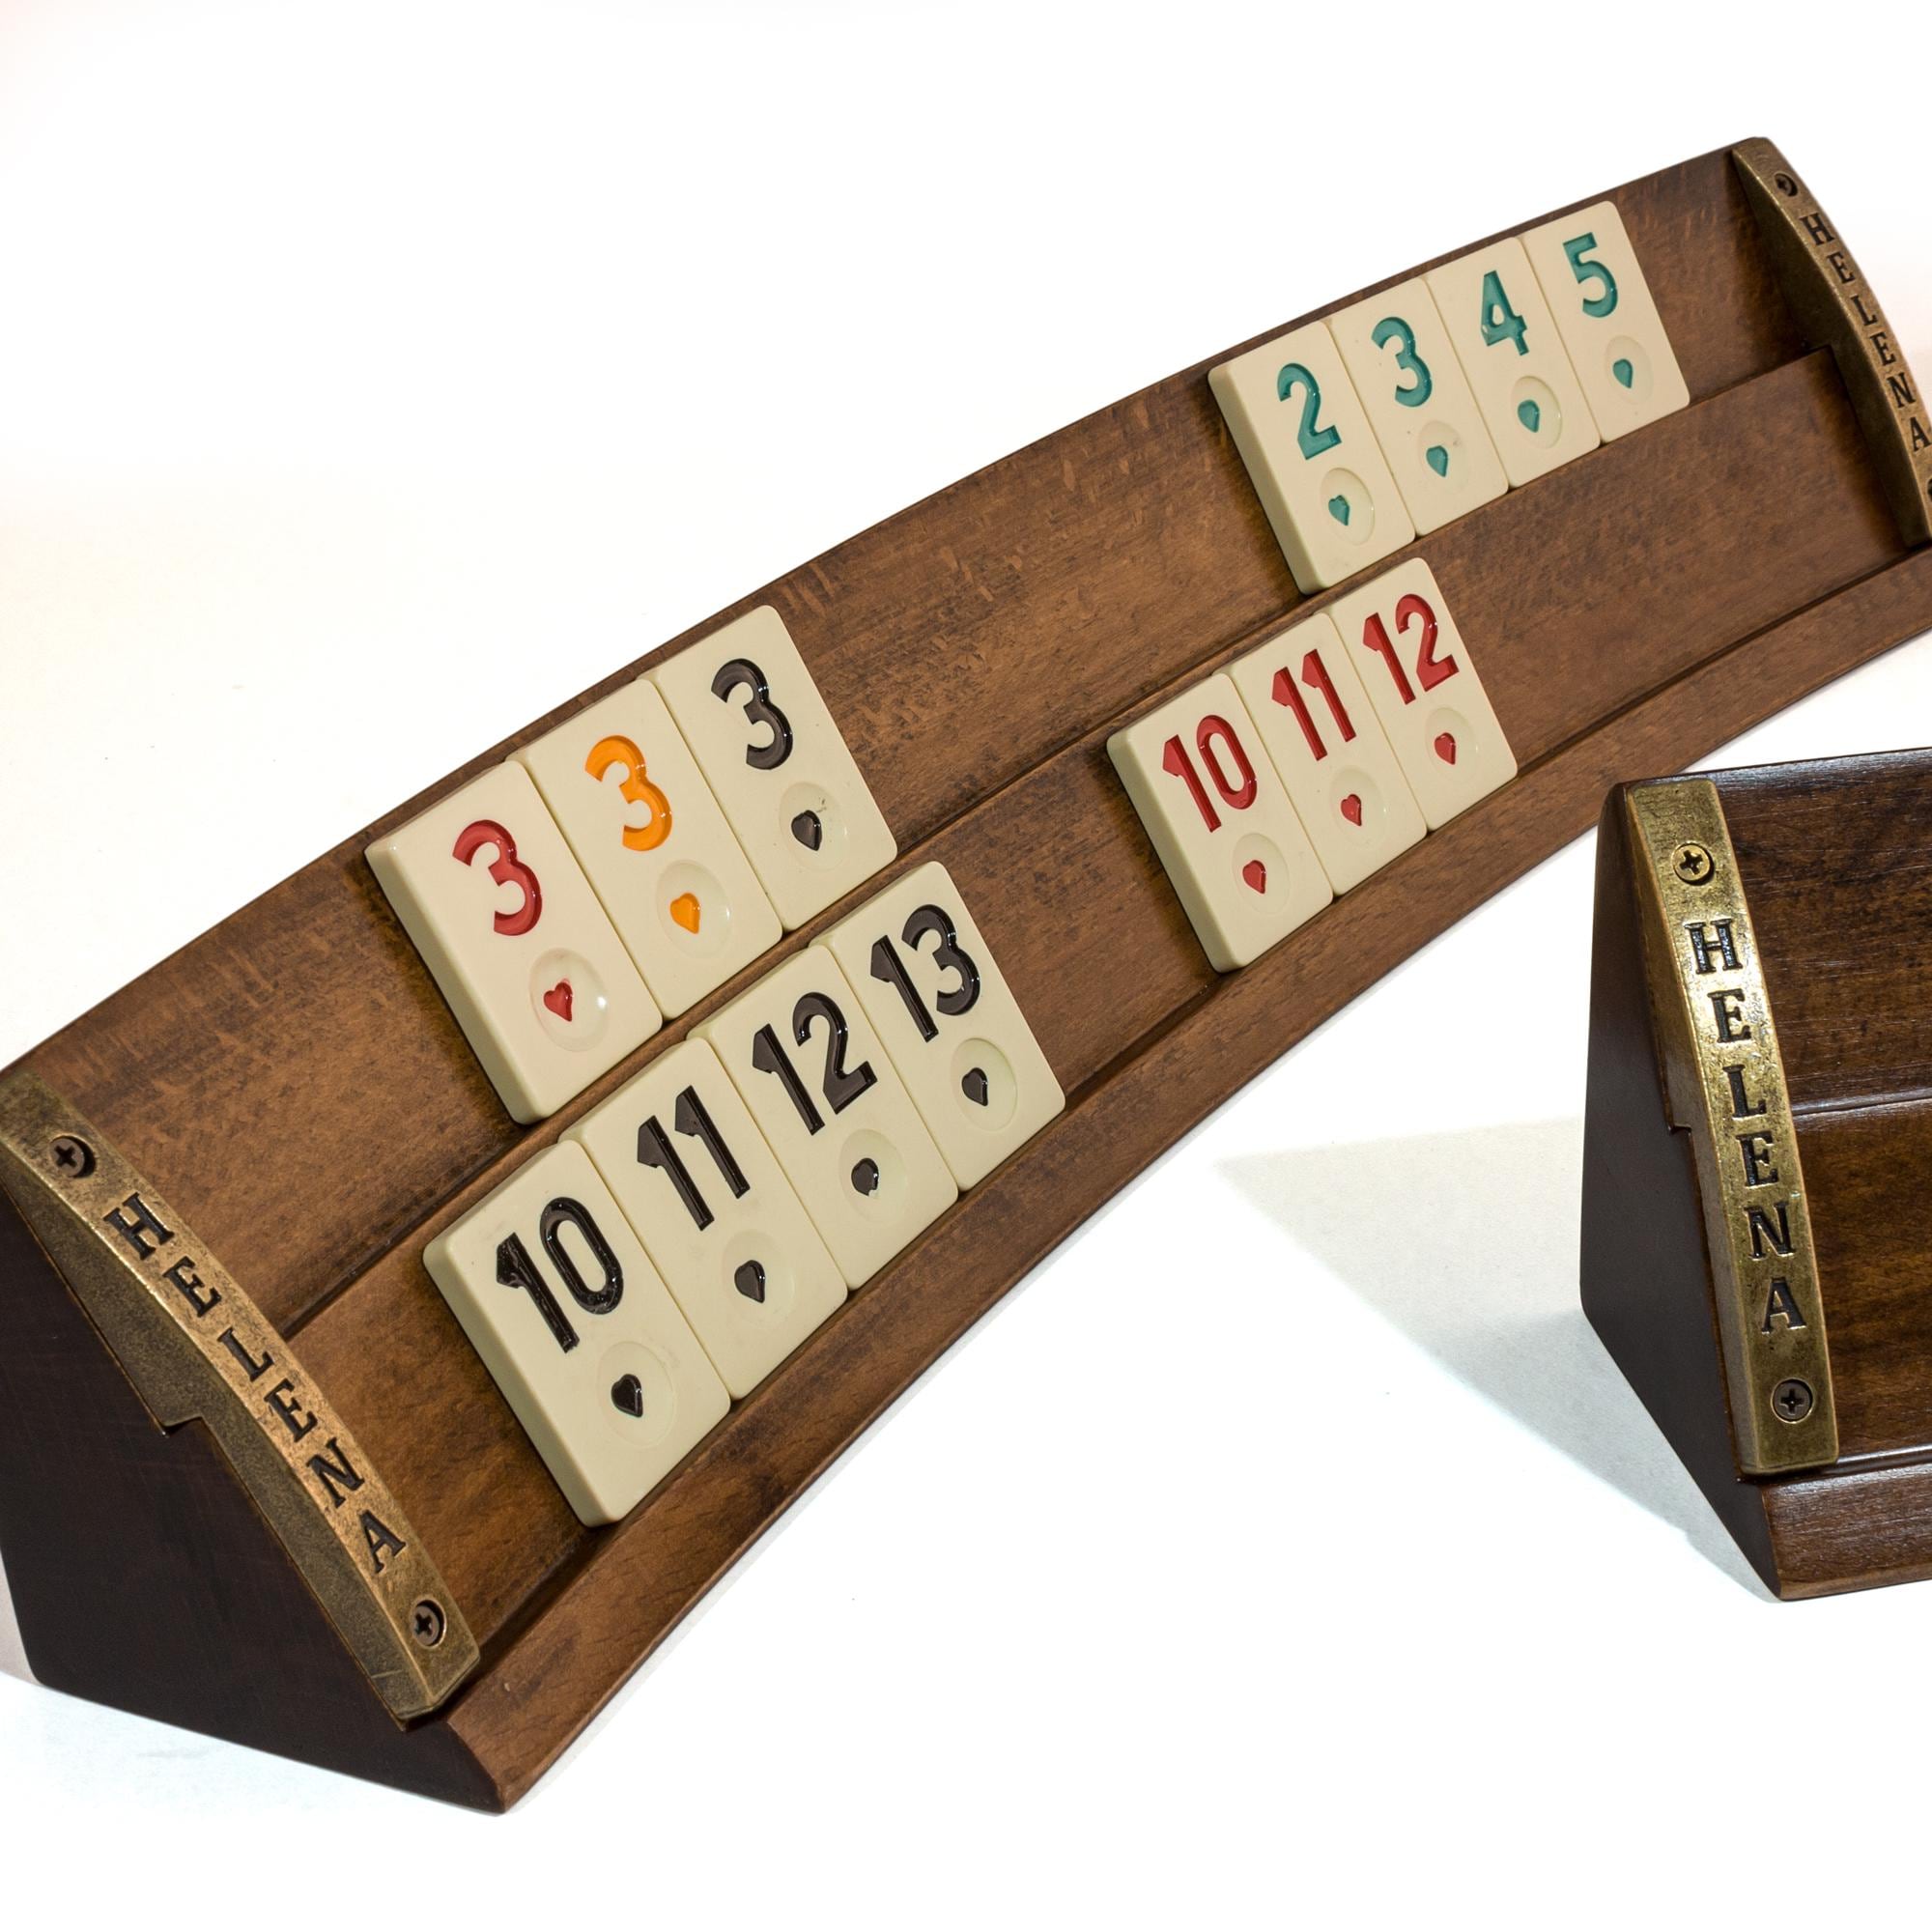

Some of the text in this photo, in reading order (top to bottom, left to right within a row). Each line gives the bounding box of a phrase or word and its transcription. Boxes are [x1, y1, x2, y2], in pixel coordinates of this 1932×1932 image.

[1276, 233, 1617, 459] 2 3 4 5
[1799, 212, 1932, 452] HELENA
[452, 659, 793, 936] 3 3 3
[1163, 592, 1460, 833] 10 11 12
[497, 903, 980, 1353] 10 11 12 13
[1684, 918, 1807, 1334] HELENA
[103, 1191, 407, 1574] HELENA
